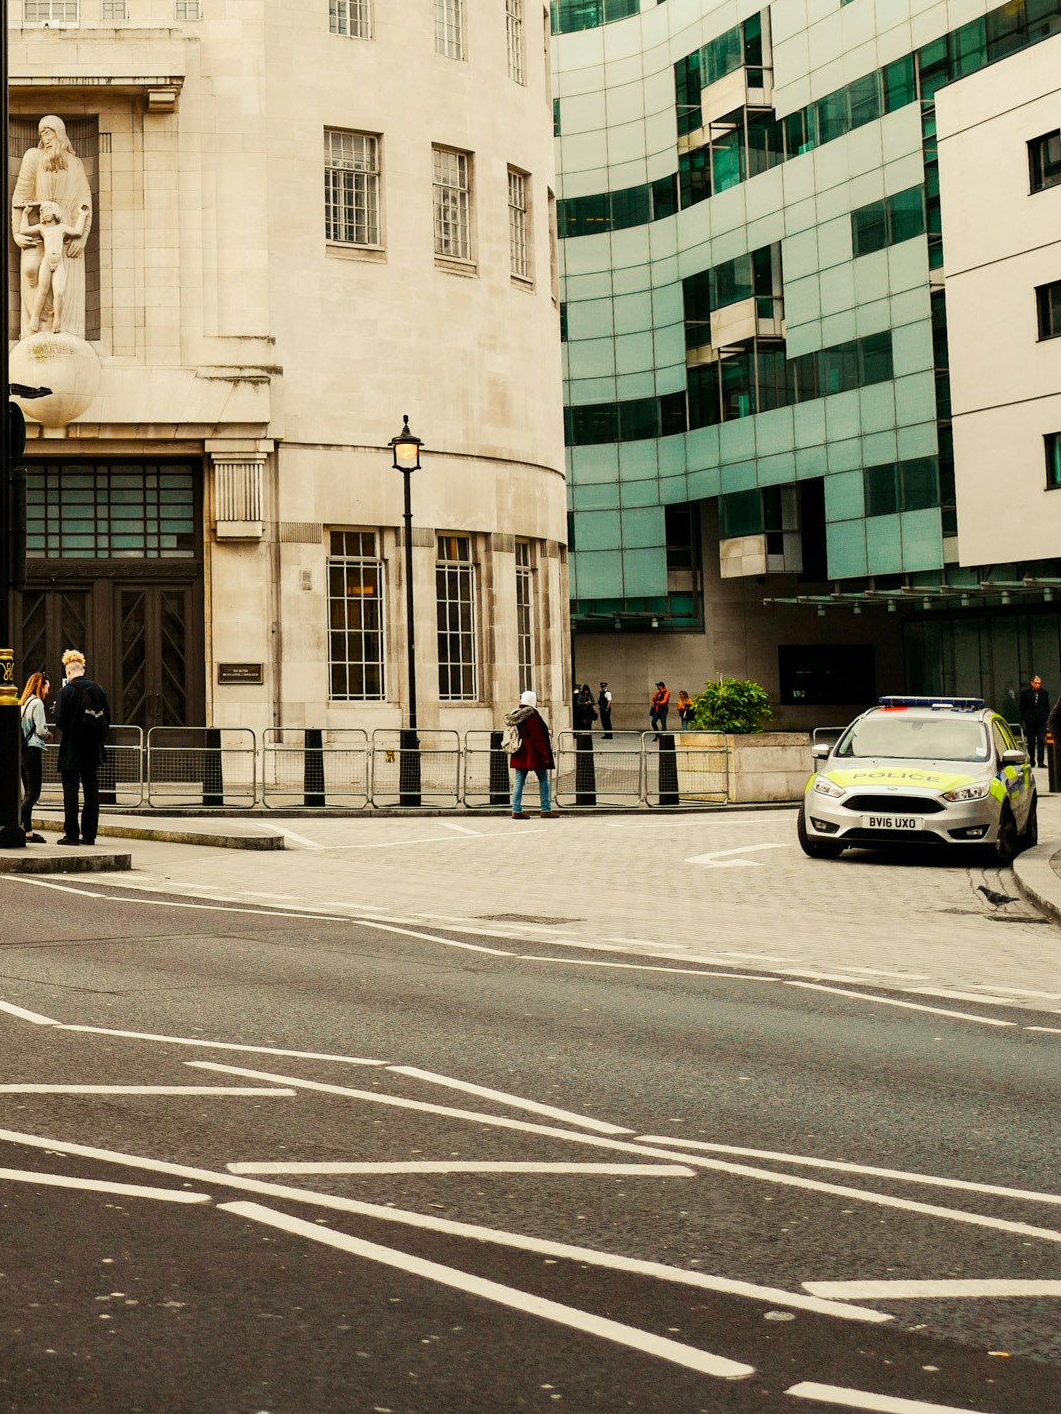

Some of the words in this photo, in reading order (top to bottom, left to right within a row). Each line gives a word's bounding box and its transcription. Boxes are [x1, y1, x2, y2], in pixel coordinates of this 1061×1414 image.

[853, 772, 941, 783] POLICE
[869, 817, 892, 827] BV16
[895, 818, 916, 828] UXO
